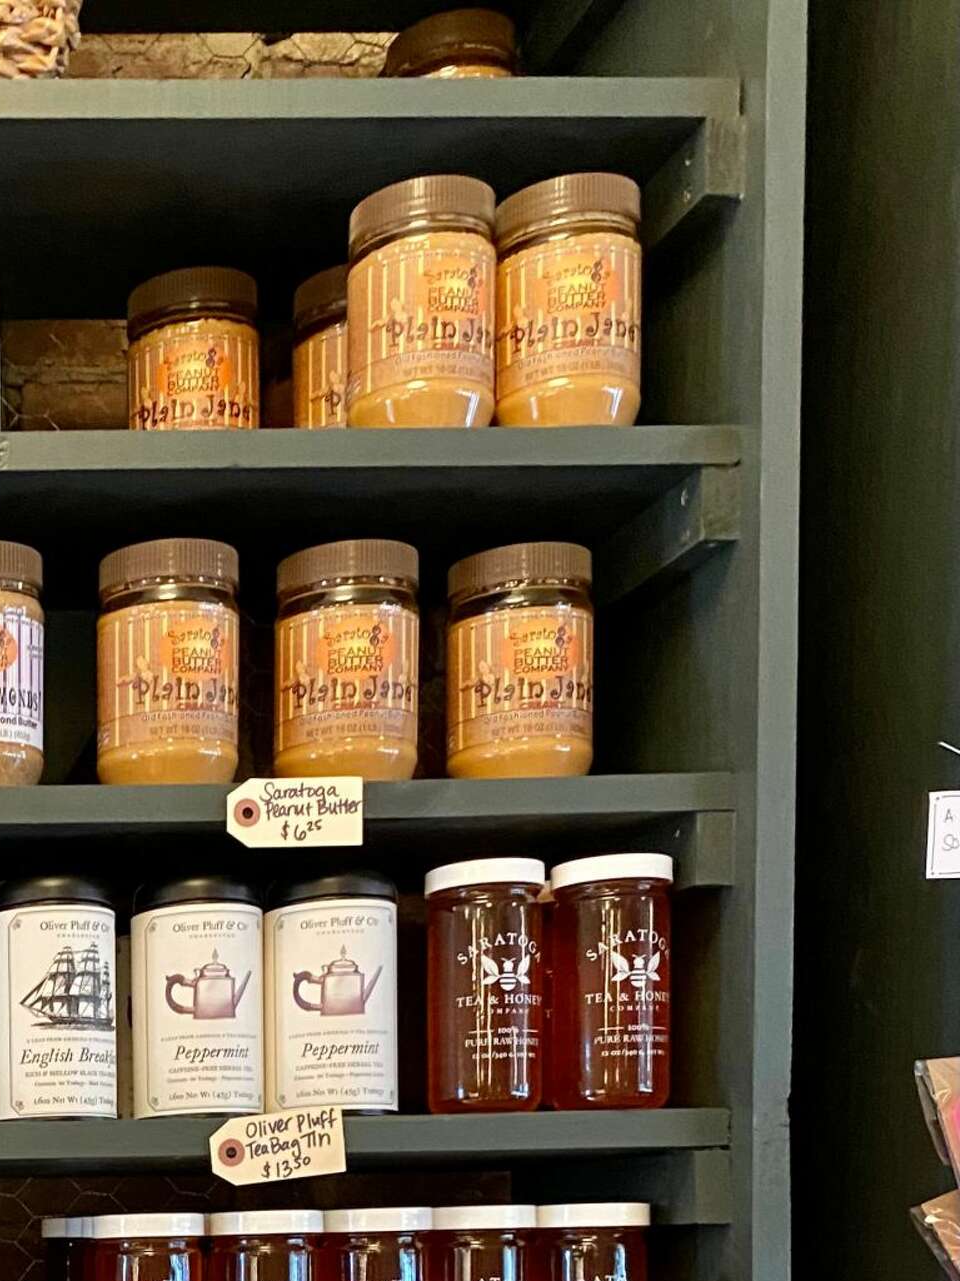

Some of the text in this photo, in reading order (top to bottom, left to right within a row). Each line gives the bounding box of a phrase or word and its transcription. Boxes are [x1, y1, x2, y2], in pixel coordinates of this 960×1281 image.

[328, 655, 384, 666] BUTTER
[514, 655, 569, 666] BUTTER
[327, 664, 384, 674] COMPANY
[513, 664, 570, 674] COMPANY
[260, 781, 339, 803] Saratoga
[264, 798, 363, 820] Peanut Butter
[300, 919, 328, 930] Oliver
[330, 917, 352, 928] Pluff
[354, 917, 365, 927] &
[456, 996, 482, 1008] TEA
[488, 995, 499, 1005] &
[20, 1048, 74, 1068] English
[174, 1044, 249, 1066] Peppermint
[302, 1040, 379, 1061] Peppermint
[245, 1107, 338, 1139] Oliver Pluff
